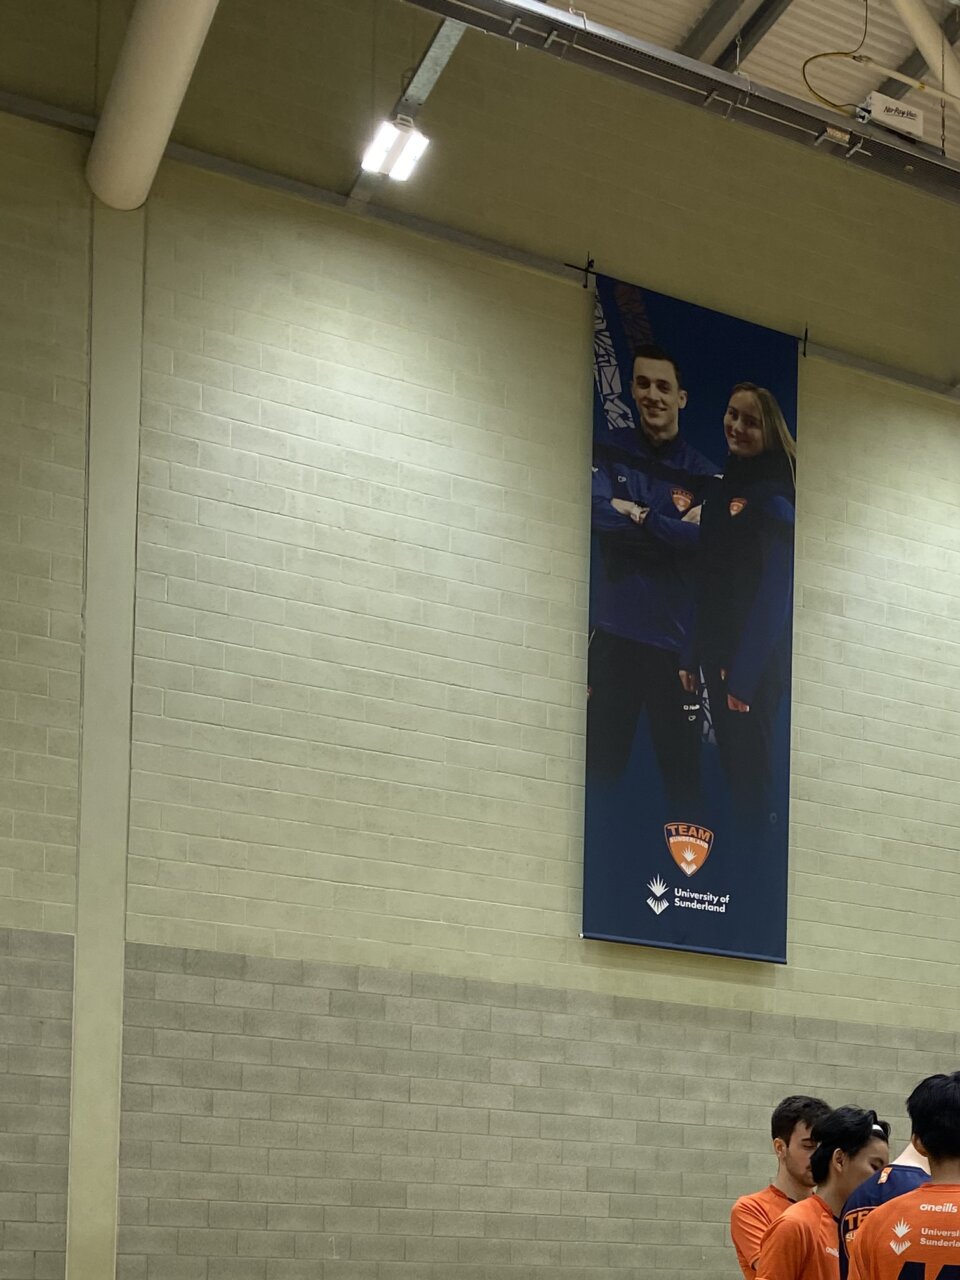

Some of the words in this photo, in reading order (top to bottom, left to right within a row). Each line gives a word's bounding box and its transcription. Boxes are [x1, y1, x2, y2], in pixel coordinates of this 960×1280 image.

[667, 825, 711, 841] TEAM
[674, 888, 719, 904] University
[719, 894, 730, 903] of
[674, 898, 726, 912] Sunderland
